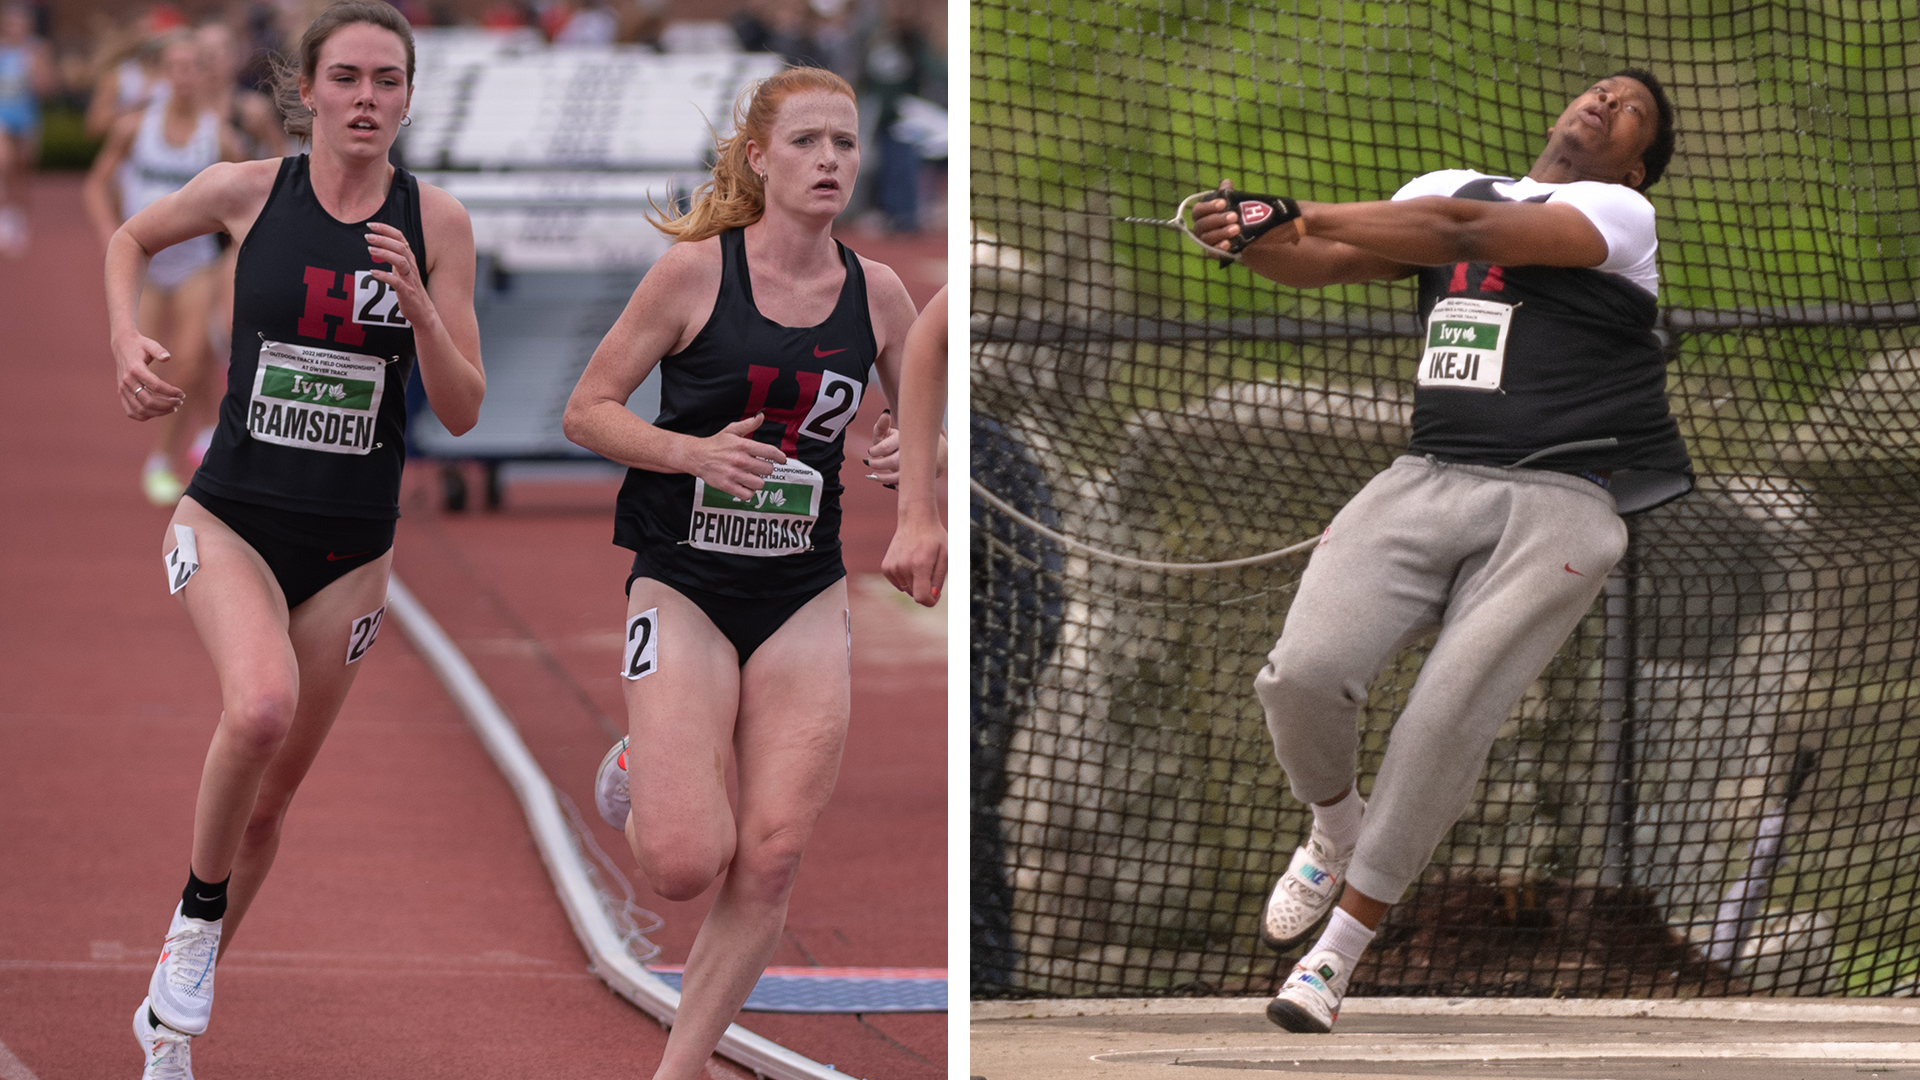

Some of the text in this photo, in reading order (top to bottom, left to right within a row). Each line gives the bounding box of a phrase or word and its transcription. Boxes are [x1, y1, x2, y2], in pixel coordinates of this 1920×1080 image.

[1245, 205, 1264, 219] H
[298, 266, 366, 347] H
[1440, 323, 1462, 344] Ivy
[269, 351, 296, 360] OUTDOOR
[297, 356, 314, 364] TRACK
[335, 362, 376, 372] CHAMPIONSHIPS
[316, 351, 351, 361] HEPTAGONAL
[1428, 352, 1481, 381] IKEJI
[309, 365, 330, 374] DWYER
[330, 368, 348, 376] TRACK
[291, 375, 328, 400] Ivy
[740, 364, 824, 459] H
[805, 380, 854, 438] 2
[251, 401, 373, 448] RAMSDEN
[773, 467, 814, 476] CHAMPIONSHIPS
[692, 510, 813, 549] PENDERGAST
[627, 616, 651, 677] 2
